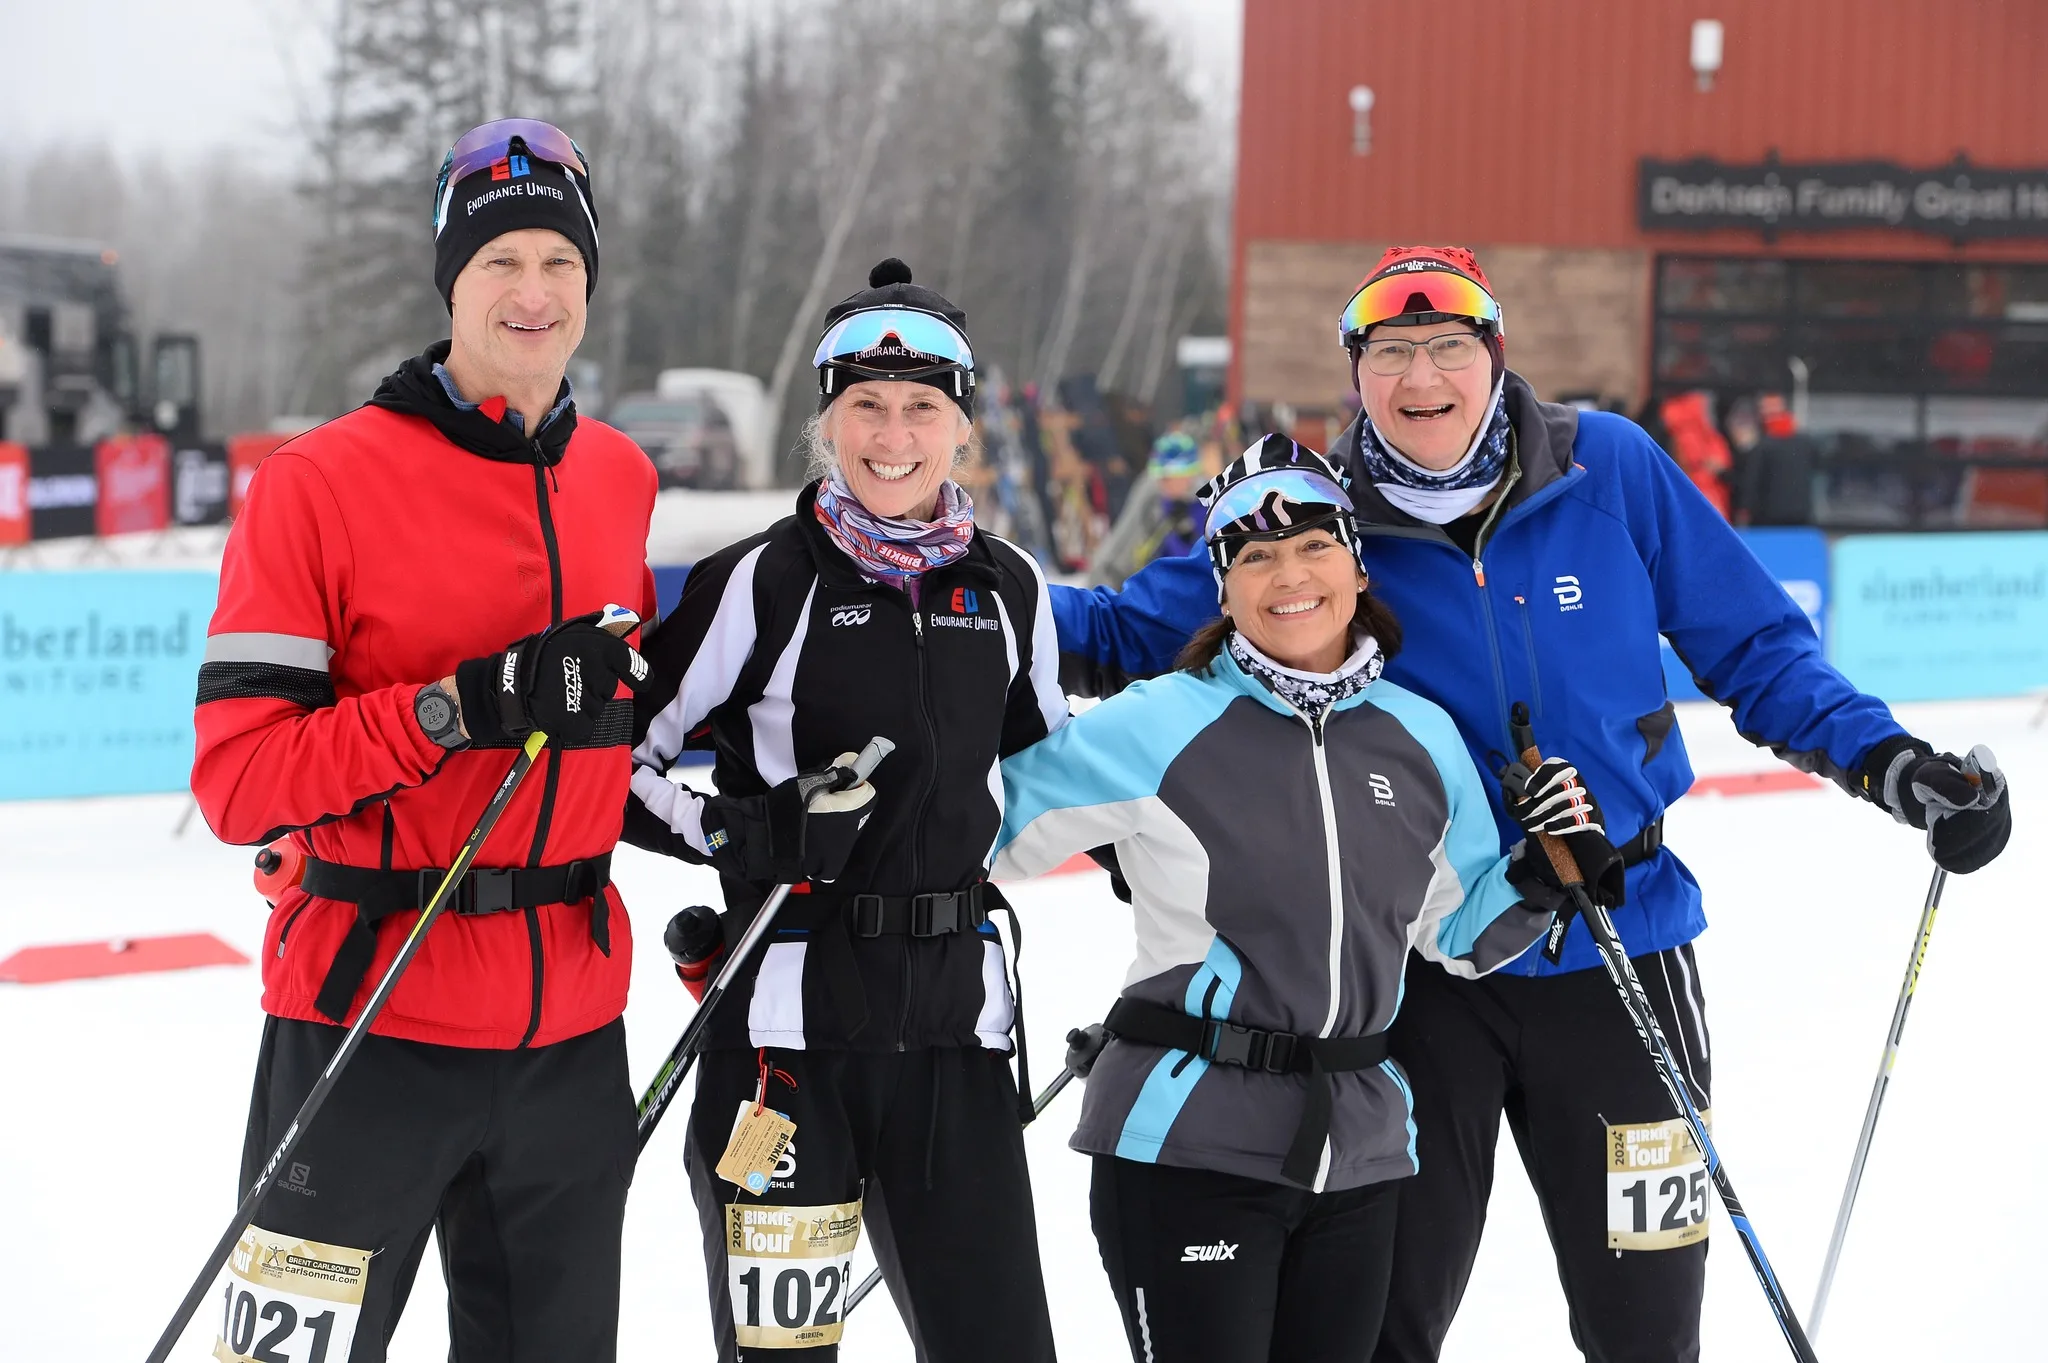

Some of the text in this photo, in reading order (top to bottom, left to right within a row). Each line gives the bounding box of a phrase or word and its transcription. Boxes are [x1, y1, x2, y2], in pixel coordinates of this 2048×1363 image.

[467, 182, 563, 216] ENDURANCE UNITED
[1799, 179, 1906, 225] Family
[855, 346, 940, 364] ENDURANCE UNITED
[880, 544, 922, 567] BIRKIE
[830, 602, 873, 613] podiumwear
[951, 587, 979, 614] EU
[930, 613, 998, 631] ENDURANCE UNITED
[422, 700, 440, 714] 1.60
[428, 711, 445, 726] 9:27
[1626, 1127, 1671, 1144] BIRKIE
[768, 1132, 790, 1165] BIRKIE
[1614, 1132, 1625, 1166] 2024
[1626, 1143, 1673, 1168] Tour
[277, 1178, 317, 1198] salomon
[732, 1212, 742, 1248] 2024
[744, 1210, 793, 1228] BIRKIE
[743, 1226, 794, 1253] Tour
[284, 1265, 359, 1286] carlsonmd.com
[287, 1256, 361, 1276] BRENT CARLSON, MD
[223, 1281, 336, 1363] 1021
